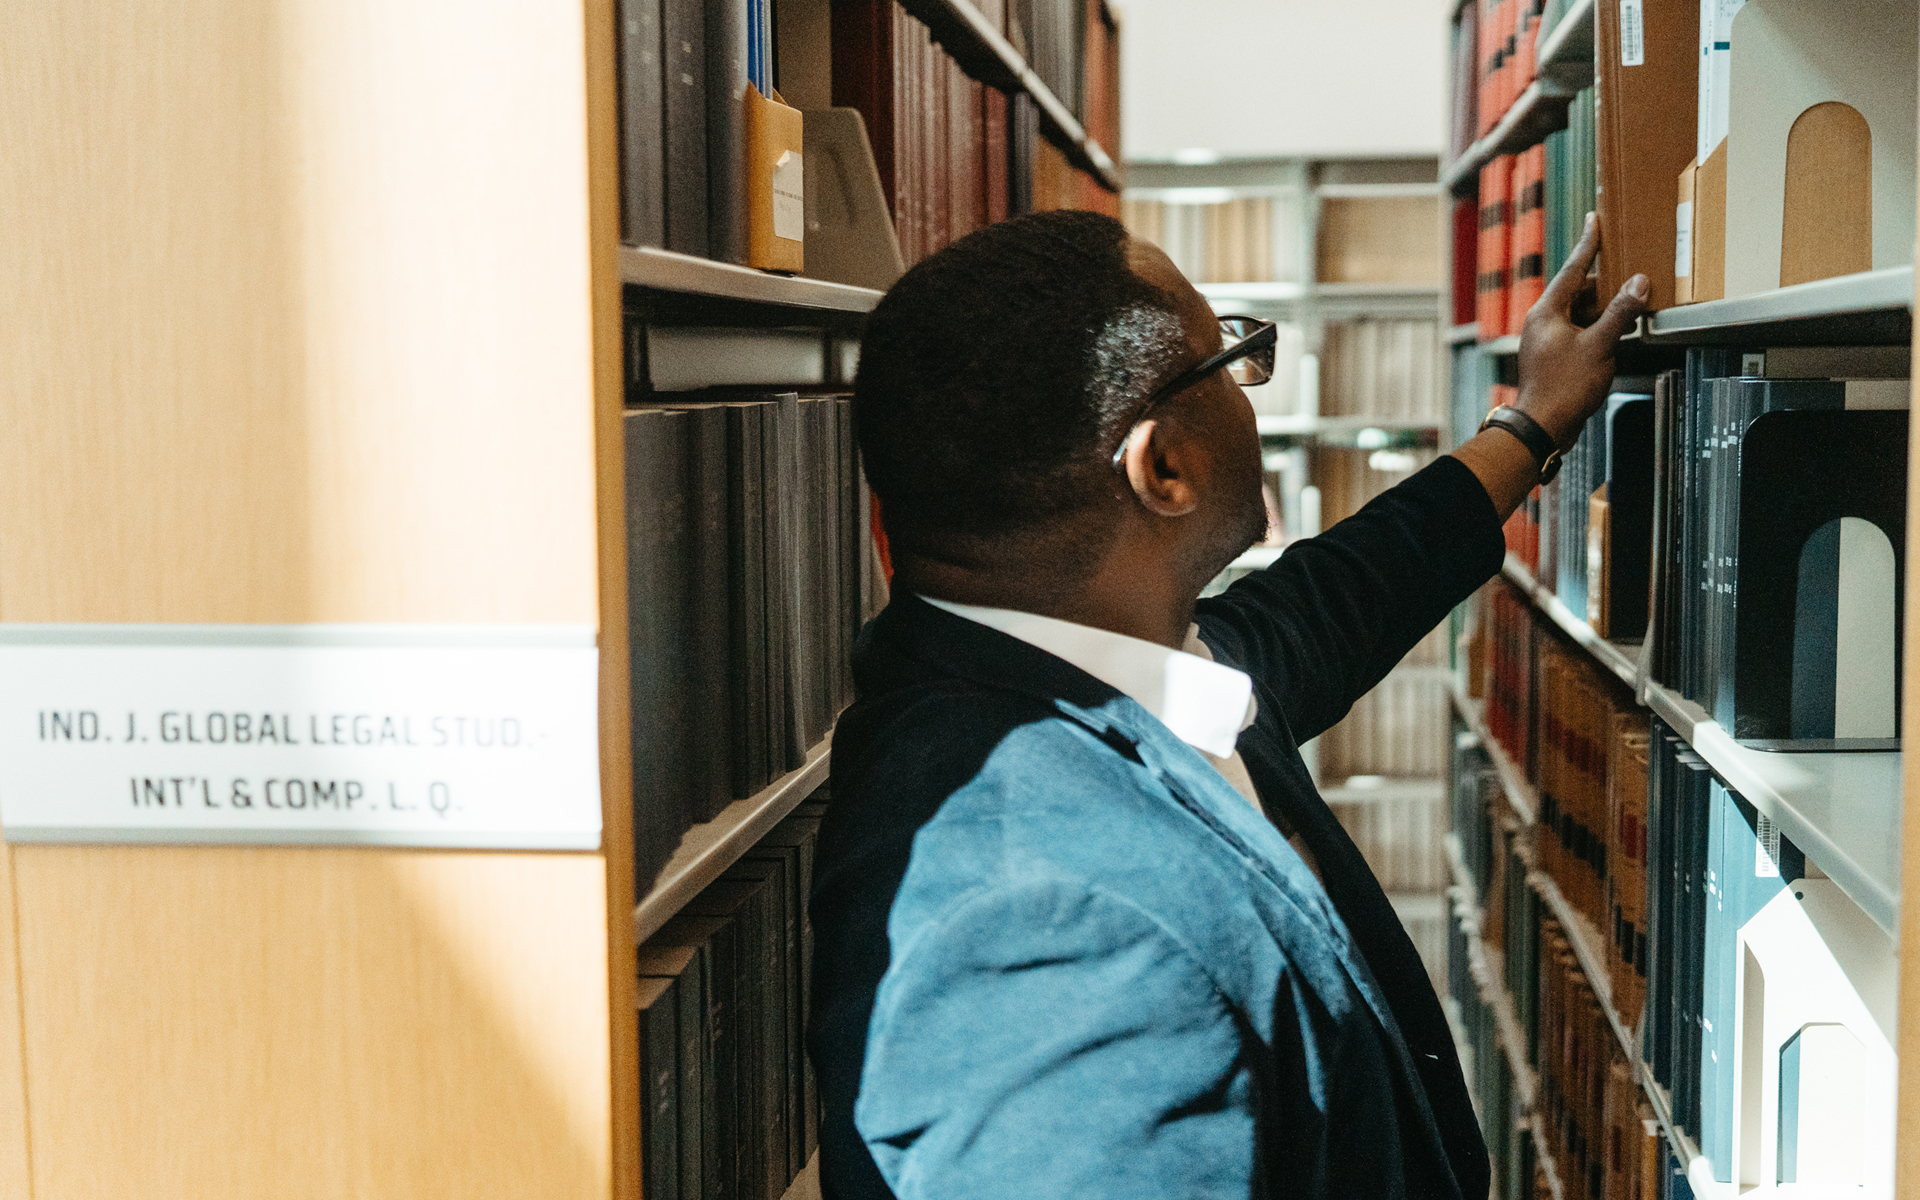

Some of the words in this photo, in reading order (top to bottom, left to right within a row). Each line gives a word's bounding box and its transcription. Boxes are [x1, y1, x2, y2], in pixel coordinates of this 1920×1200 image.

[37, 709, 113, 743] IND.
[123, 711, 149, 744] J.
[159, 711, 300, 746] GLOBAL
[309, 713, 420, 747] LEGAL
[130, 776, 221, 809] INT'L
[229, 777, 255, 810] &
[264, 778, 379, 812] COMP.
[386, 781, 418, 812] L.
[427, 781, 465, 820] Q.
